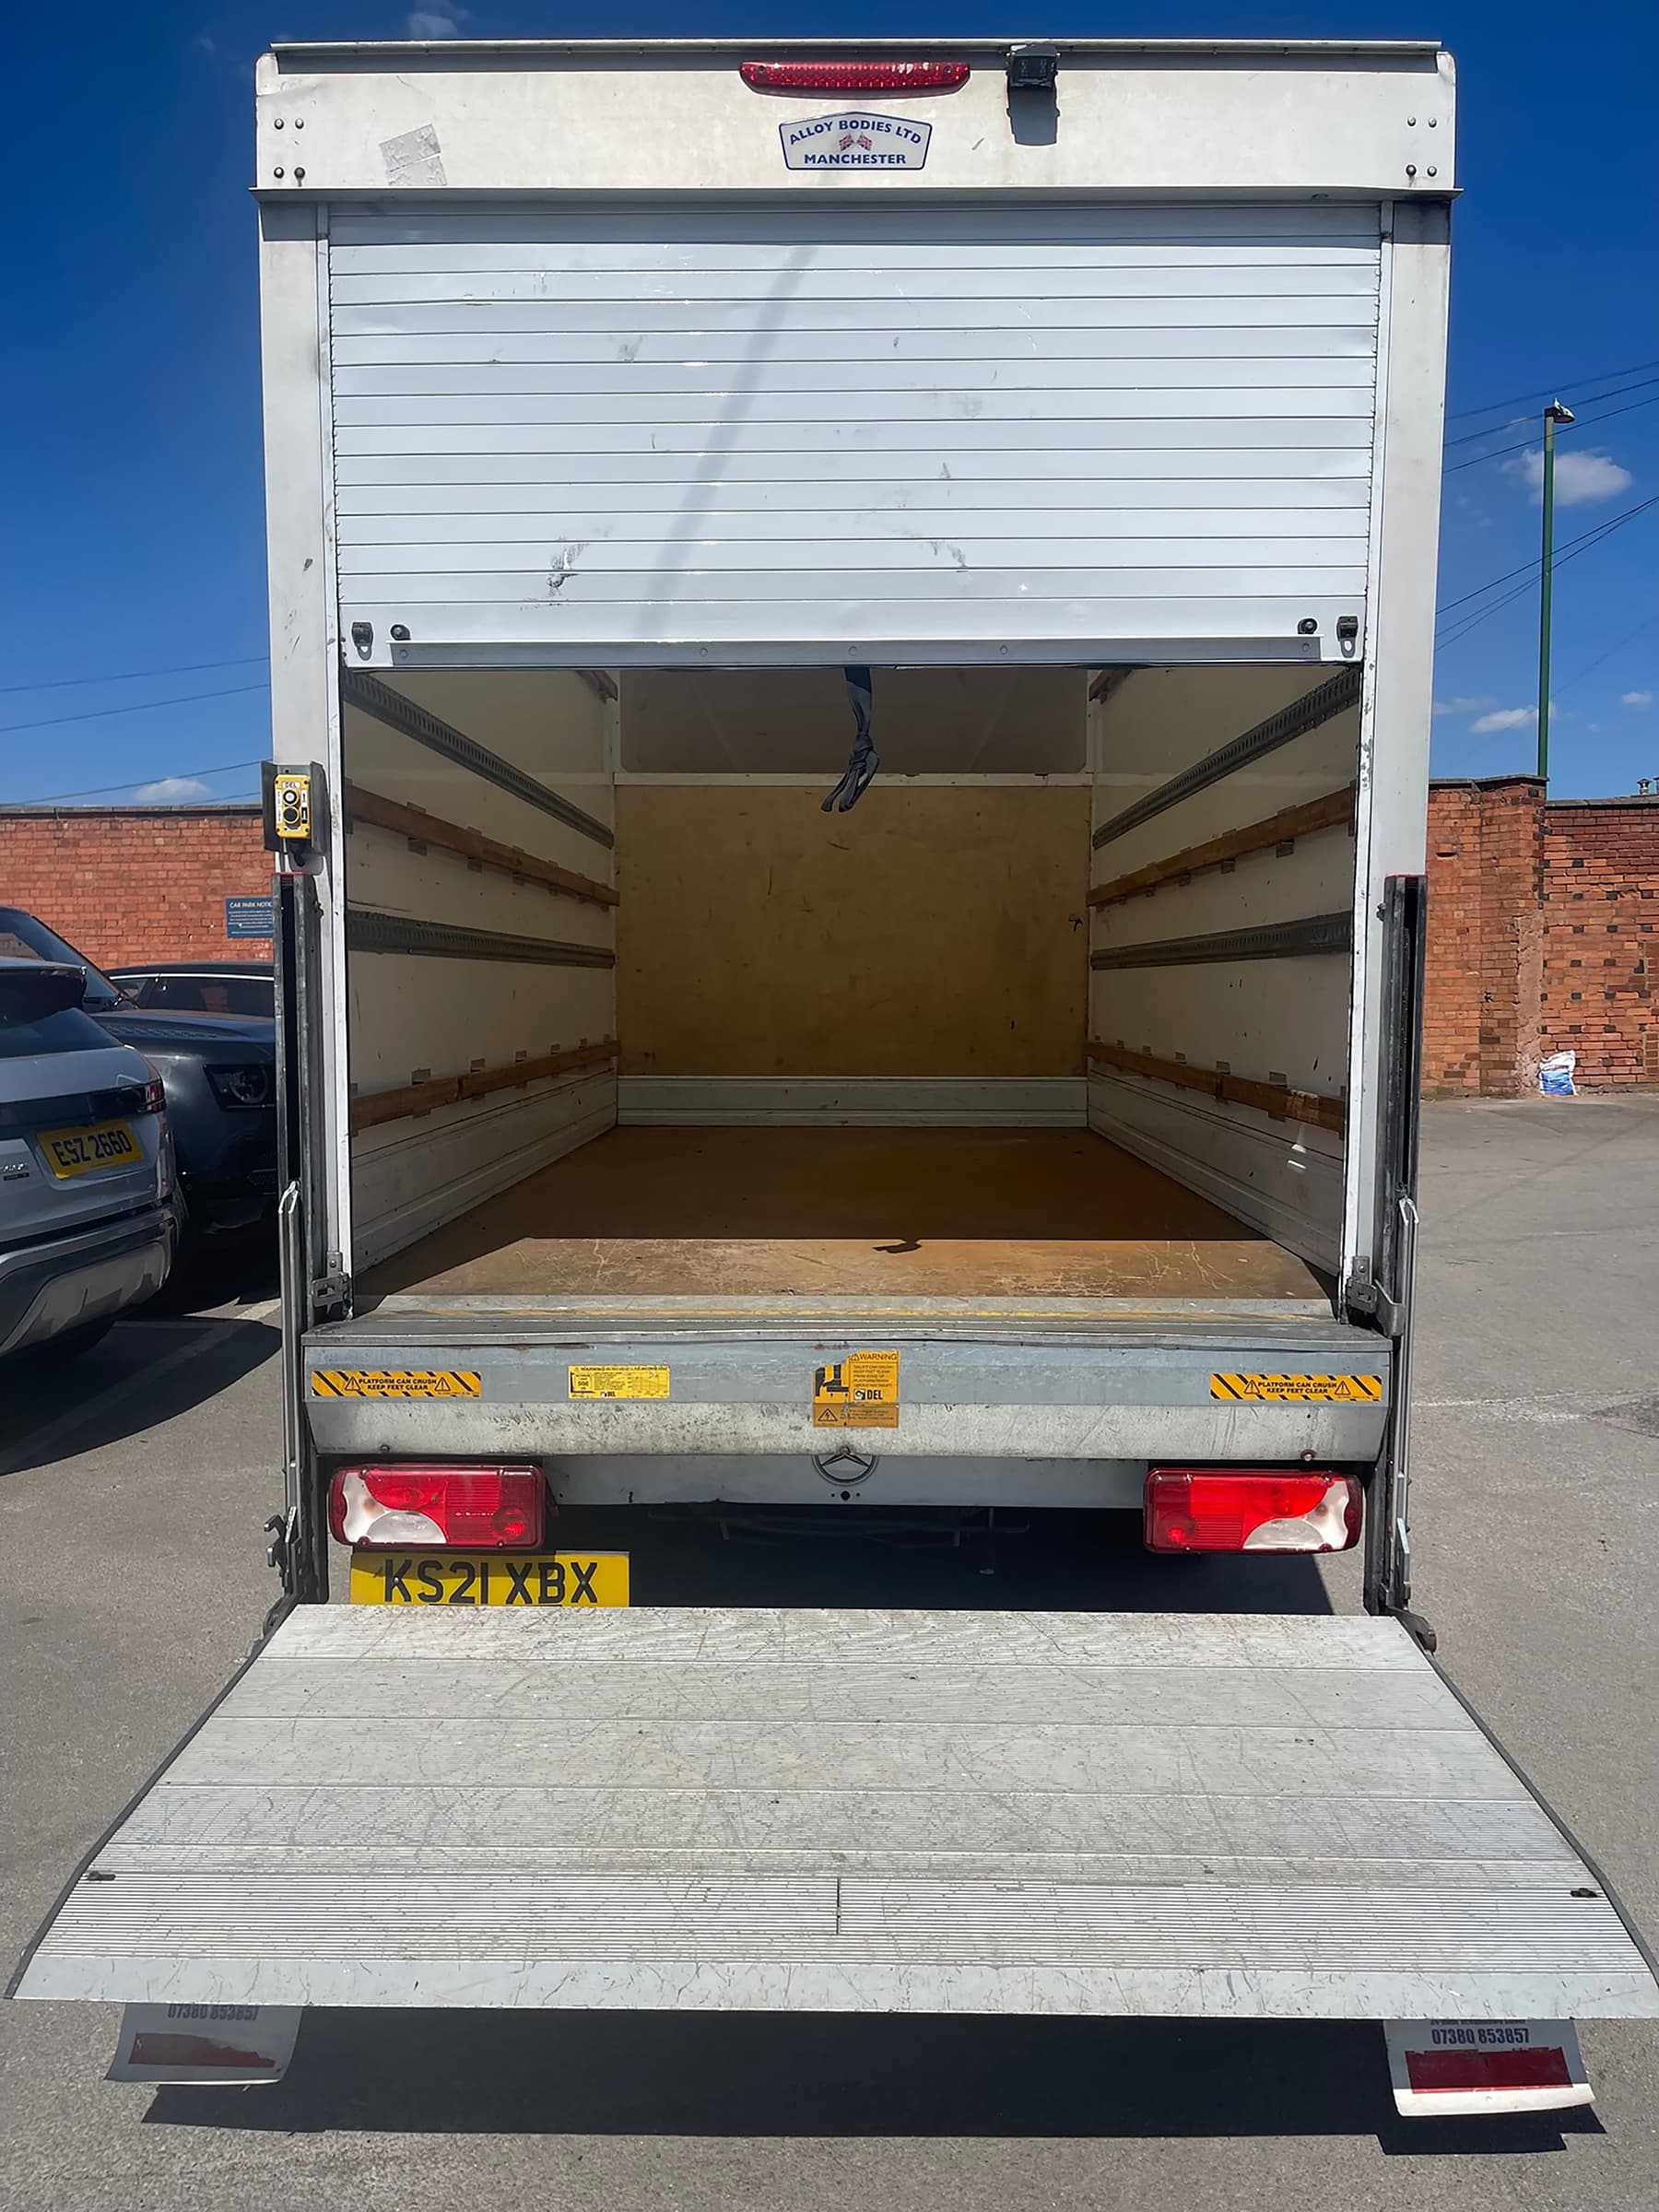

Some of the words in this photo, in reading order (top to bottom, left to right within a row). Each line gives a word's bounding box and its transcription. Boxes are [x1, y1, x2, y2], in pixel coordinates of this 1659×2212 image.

[789, 121, 833, 146] ALLOY
[839, 120, 892, 134] BODIES
[895, 125, 922, 145] LTD
[804, 153, 907, 164] MANCHESTER
[52, 1138, 90, 1166] ESZ
[88, 1130, 133, 1159] 2660
[860, 1353, 898, 1361] WARNING
[867, 1390, 883, 1400] DEL
[384, 1559, 488, 1604] KS21
[505, 1562, 598, 1604] XBX
[1431, 2029, 1476, 2045] 07380
[1477, 2027, 1529, 2044] 853857
